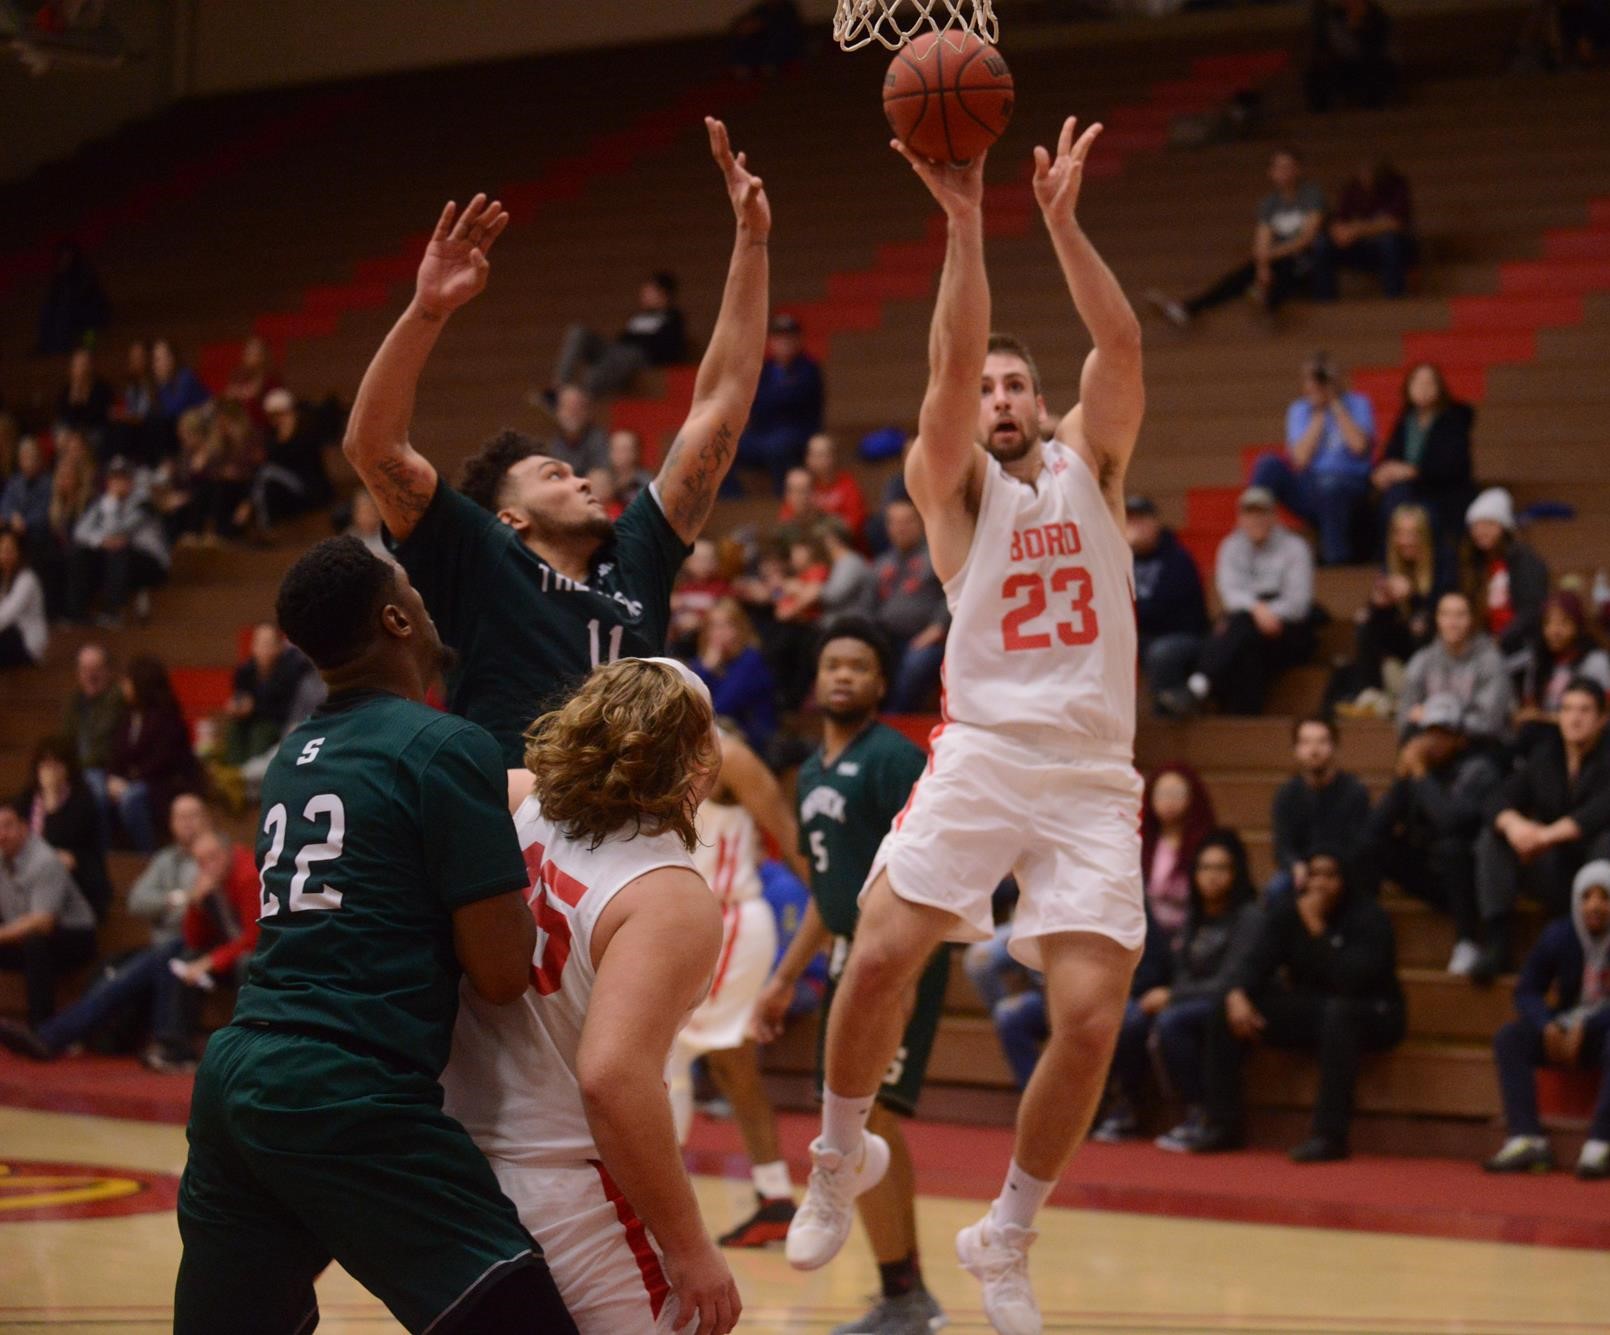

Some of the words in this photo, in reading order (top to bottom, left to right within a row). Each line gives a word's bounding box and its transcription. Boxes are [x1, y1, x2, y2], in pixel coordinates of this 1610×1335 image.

[1002, 566, 1099, 651] 23
[587, 618, 624, 667] 11
[296, 737, 326, 766] S
[256, 794, 346, 921] 22
[809, 830, 829, 873] 5
[522, 841, 589, 996] 5
